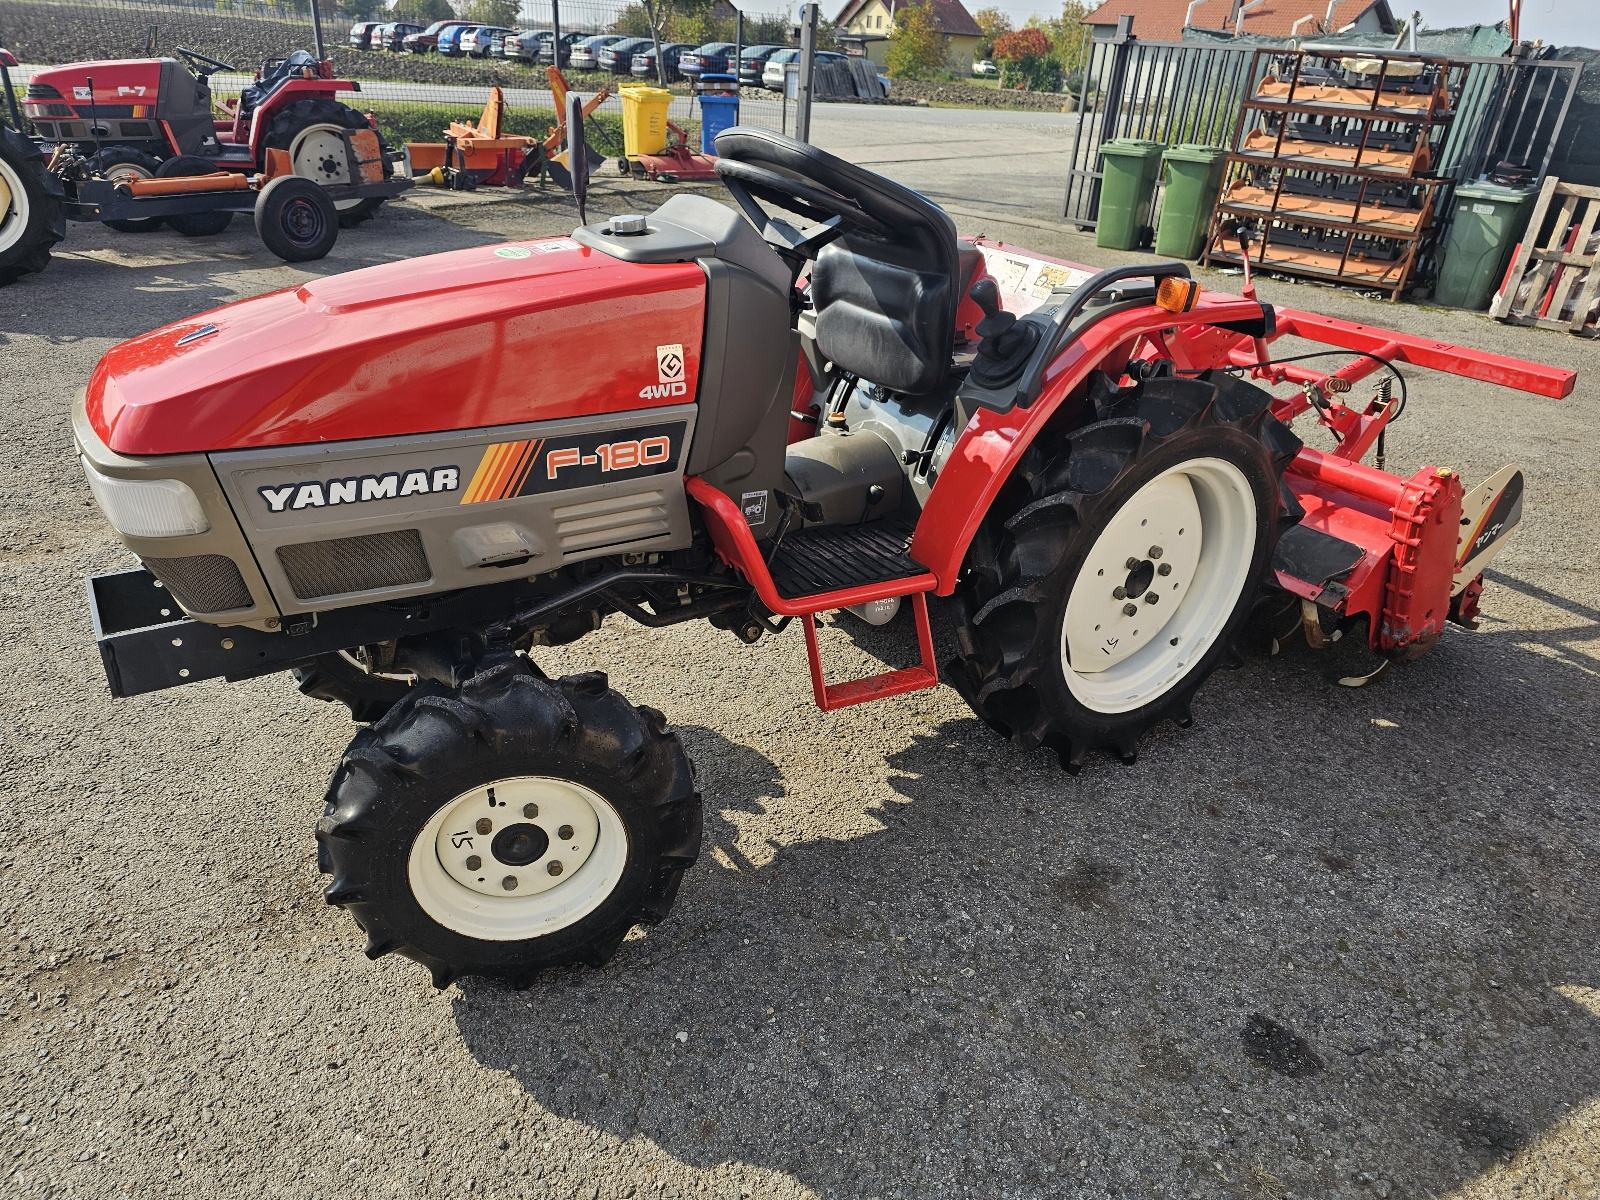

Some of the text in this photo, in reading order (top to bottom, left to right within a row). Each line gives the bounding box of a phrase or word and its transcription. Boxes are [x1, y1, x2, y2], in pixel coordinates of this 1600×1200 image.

[117, 86, 146, 97] F-7
[639, 381, 687, 399] 4WD
[546, 436, 670, 480] F-180
[259, 466, 459, 512] YANMAR
[1475, 523, 1503, 548] ヤンマー
[451, 830, 473, 850] 15
